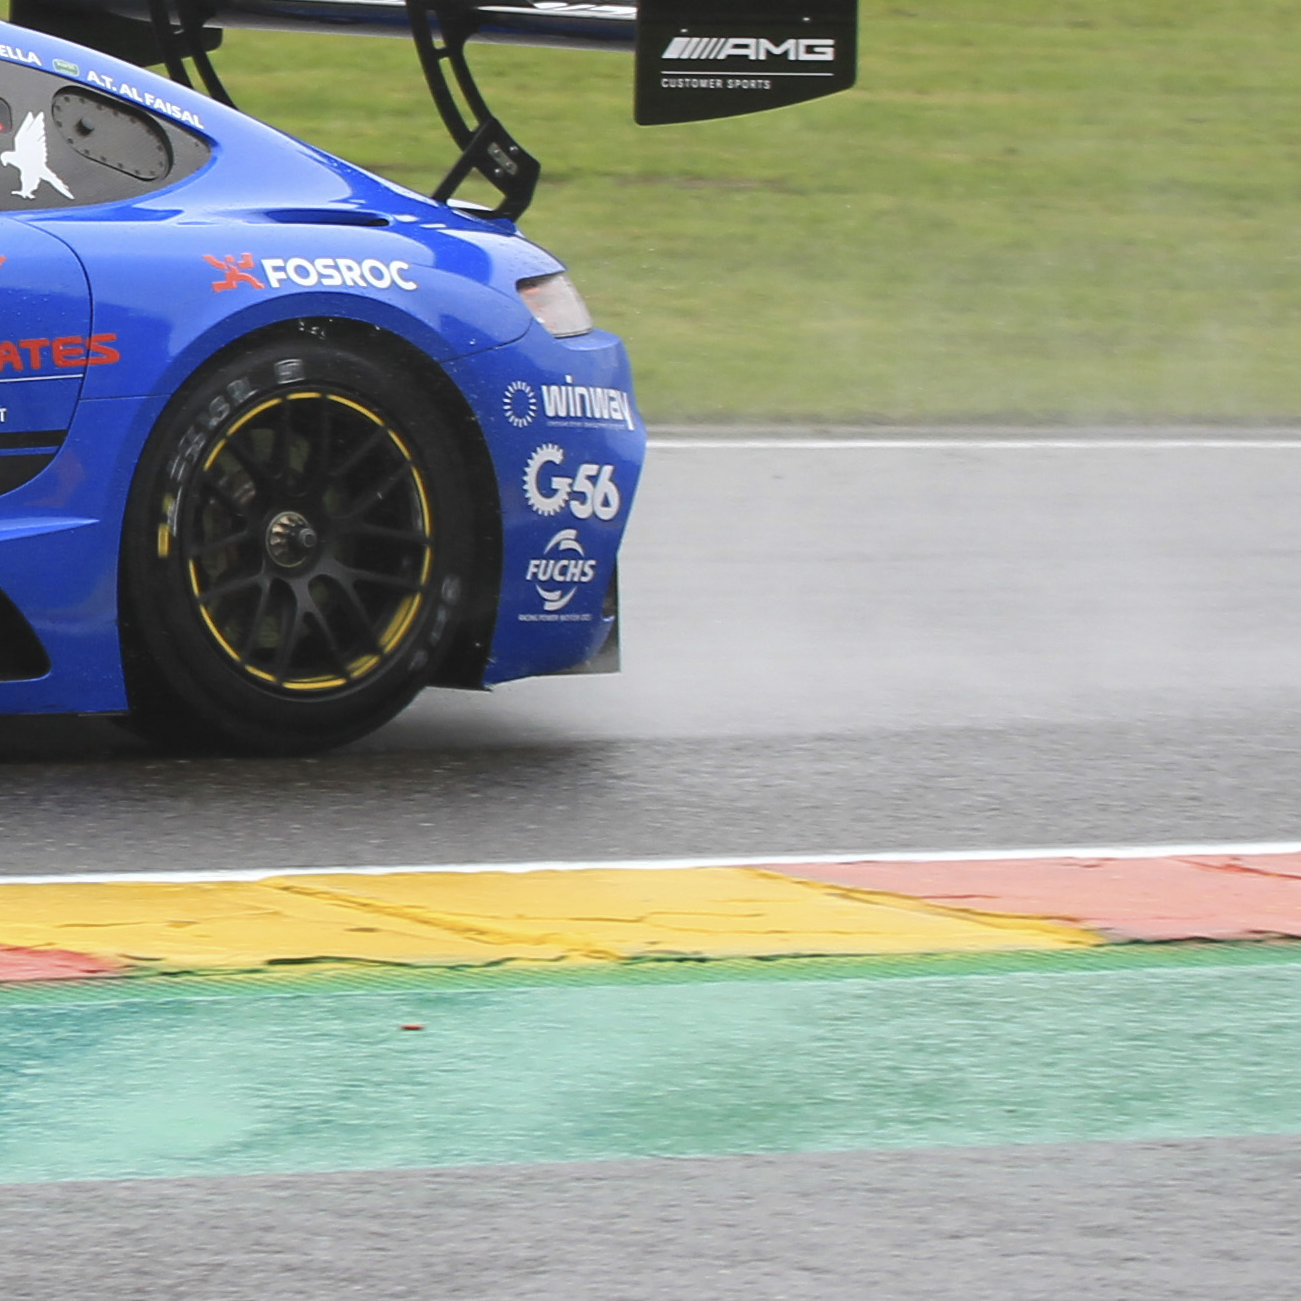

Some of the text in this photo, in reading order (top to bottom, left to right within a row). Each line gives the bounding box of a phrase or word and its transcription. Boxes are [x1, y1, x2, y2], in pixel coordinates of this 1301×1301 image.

[717, 37, 835, 61] AMG
[660, 77, 772, 90] CUSTOMER SPORTS
[144, 94, 204, 129] FAISAL
[261, 257, 418, 291] FOSROC
[541, 374, 635, 431] winway
[525, 559, 597, 583] FUCHS
